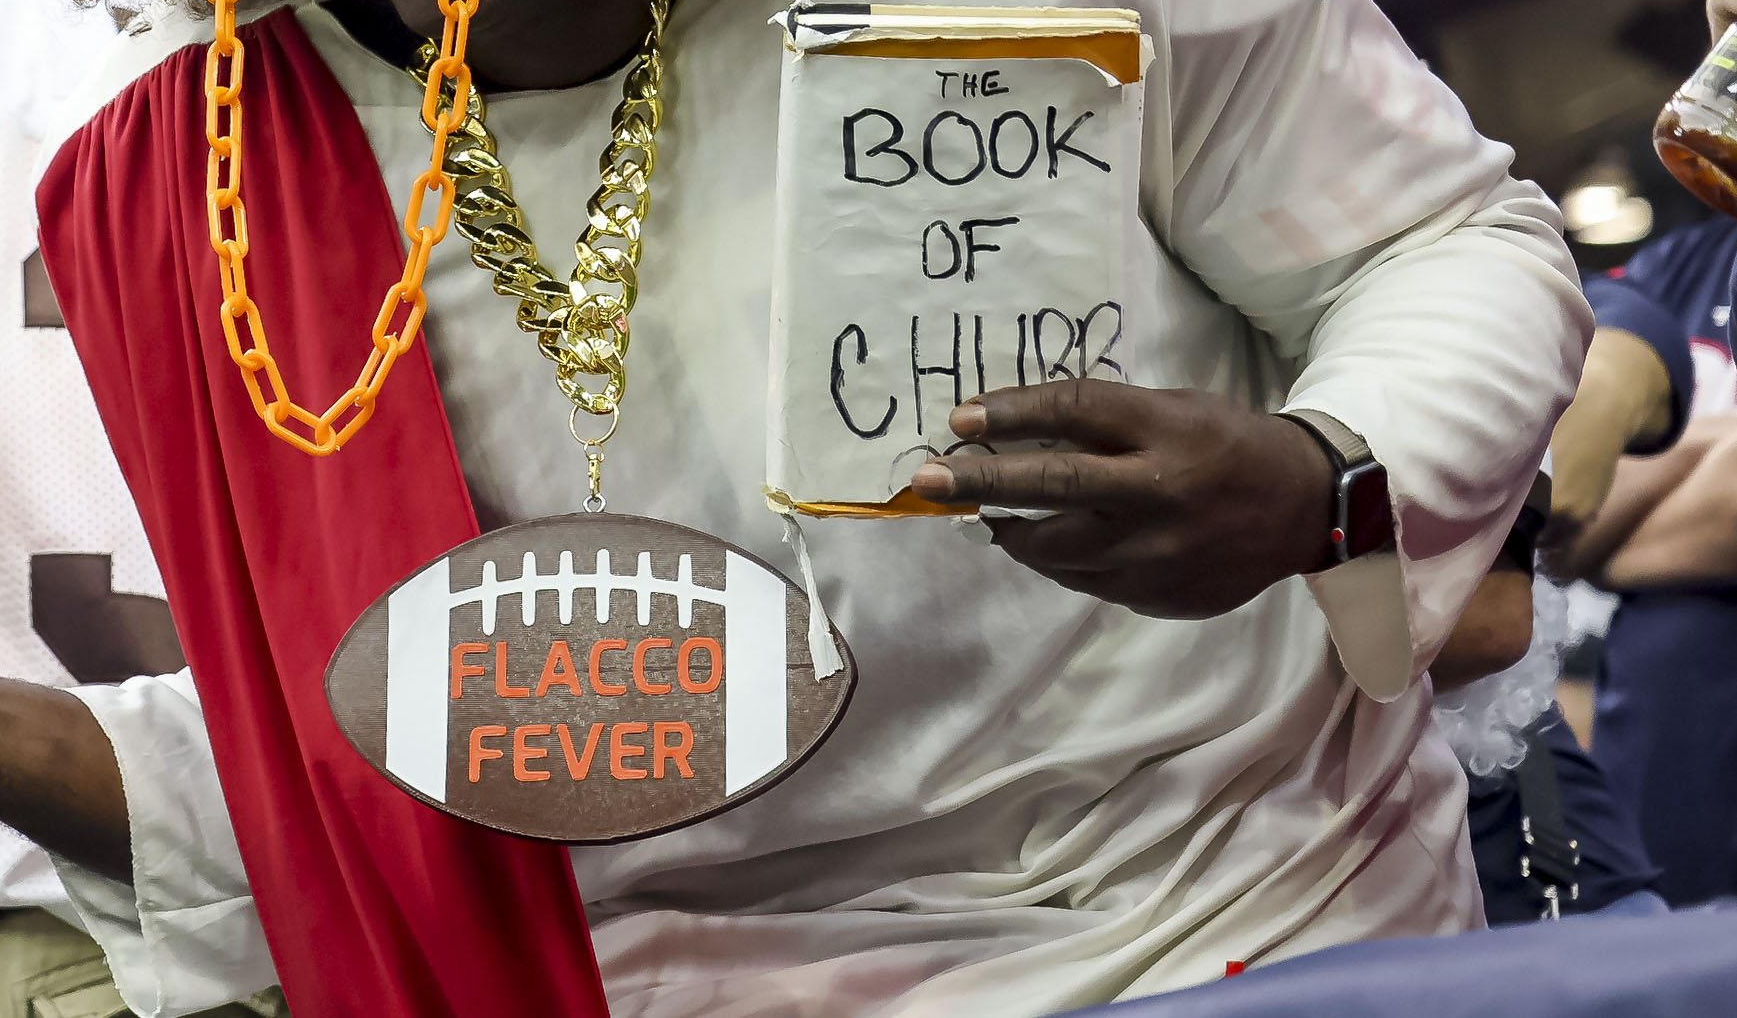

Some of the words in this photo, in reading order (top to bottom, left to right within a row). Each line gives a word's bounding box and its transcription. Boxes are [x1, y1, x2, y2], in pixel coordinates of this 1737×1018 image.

[935, 69, 1009, 97] THE
[842, 105, 1111, 187] BOOK
[920, 217, 1021, 283] OF
[449, 635, 723, 700] FLACCO
[467, 720, 695, 783] FEVER
